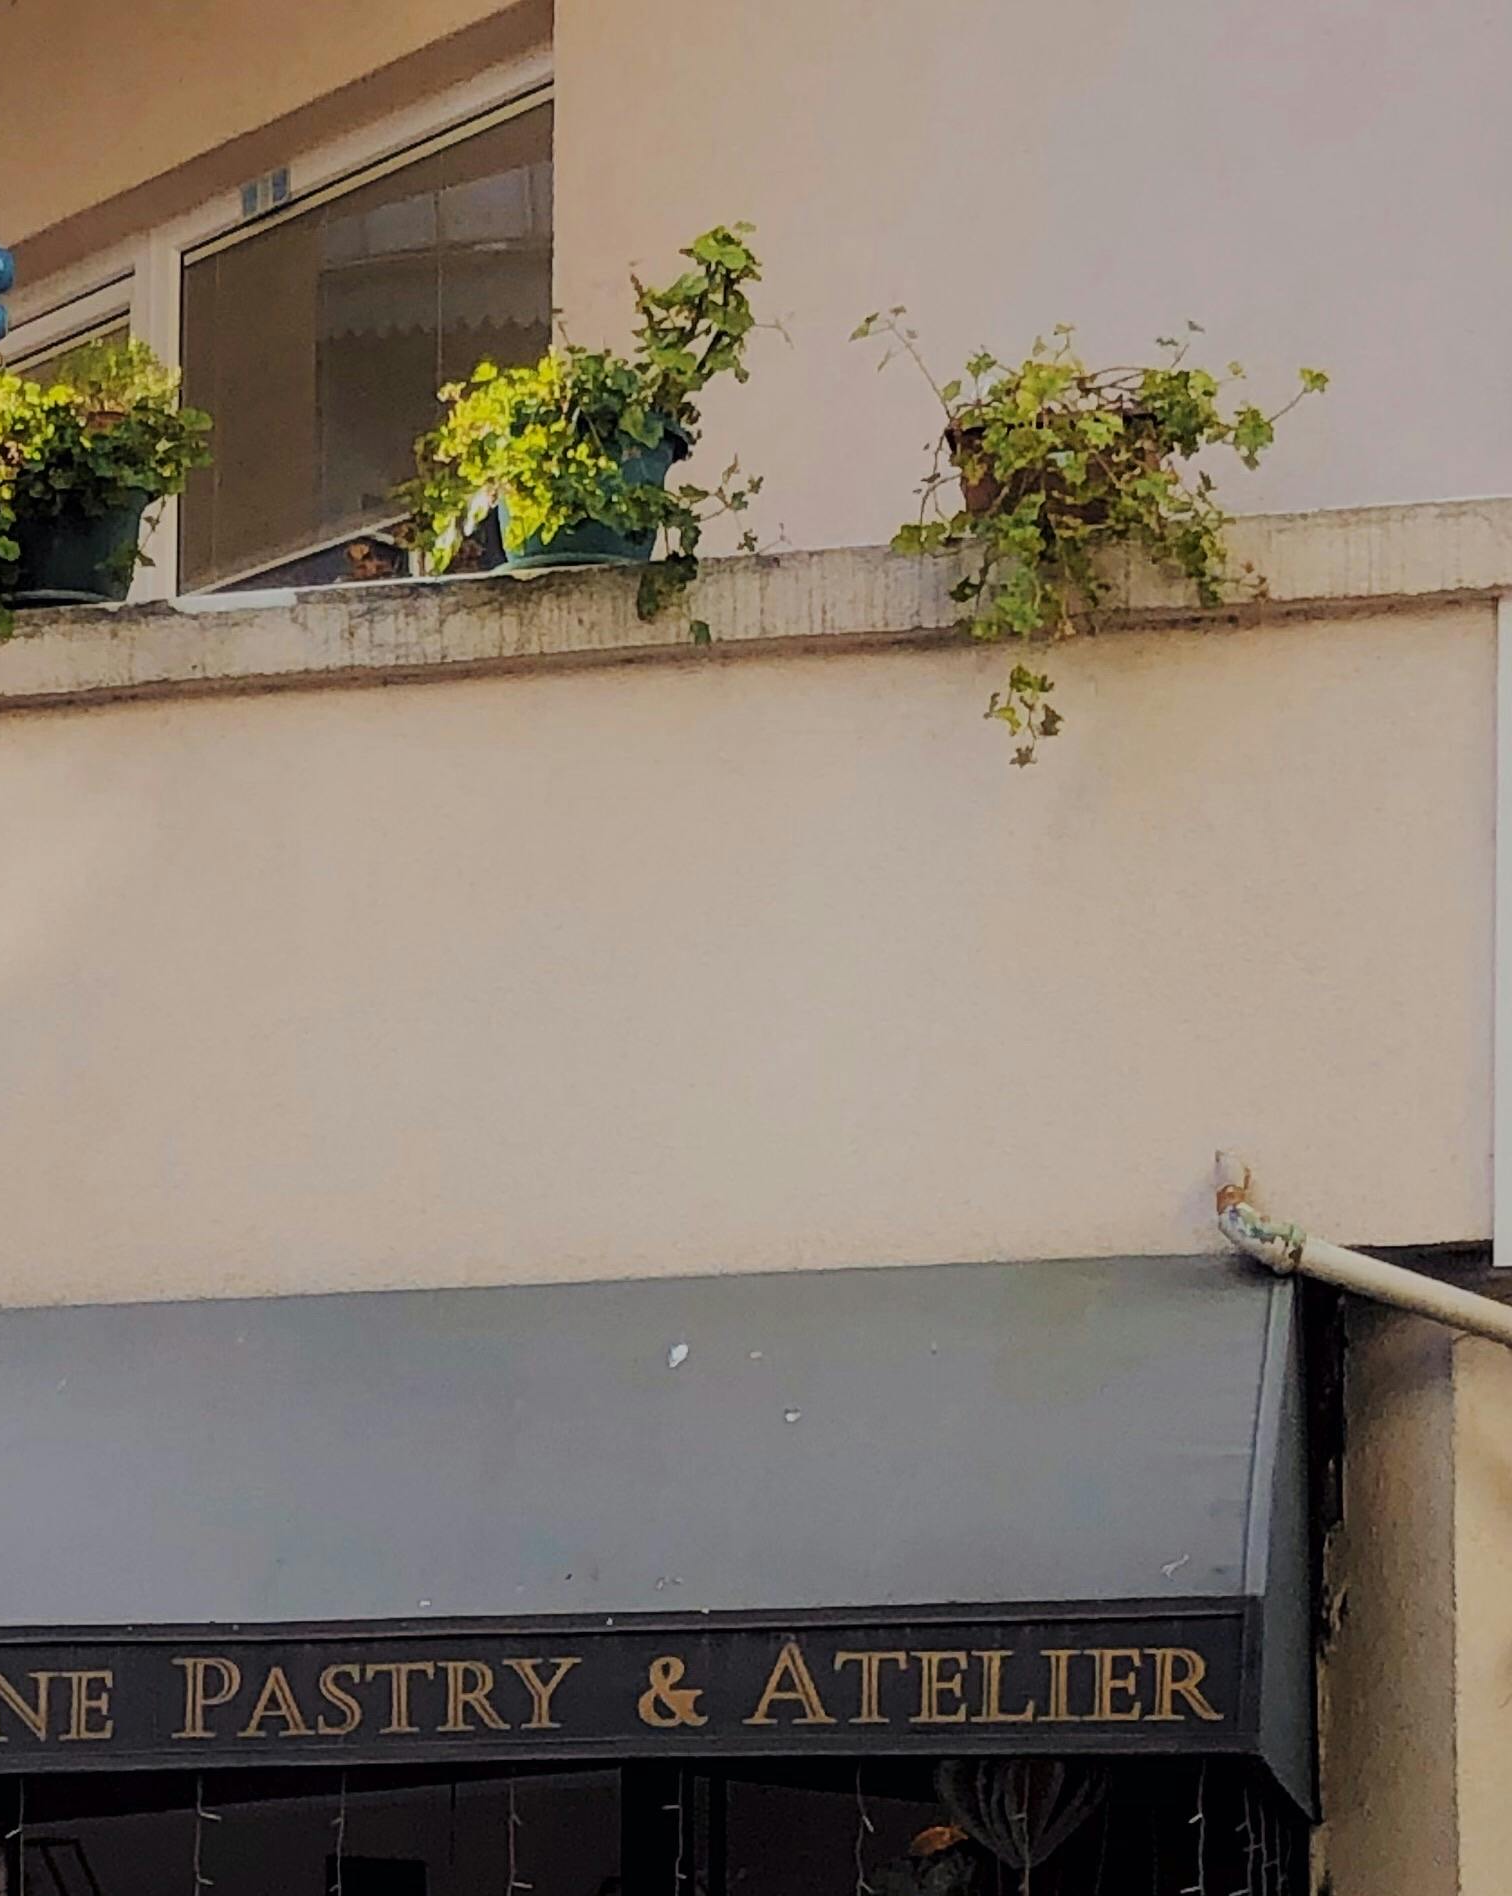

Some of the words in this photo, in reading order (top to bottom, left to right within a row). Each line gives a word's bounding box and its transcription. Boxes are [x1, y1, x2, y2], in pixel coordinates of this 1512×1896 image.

[171, 1656, 583, 1739] PASTRY
[637, 1655, 709, 1727] &
[742, 1640, 1224, 1725] ATELIER
